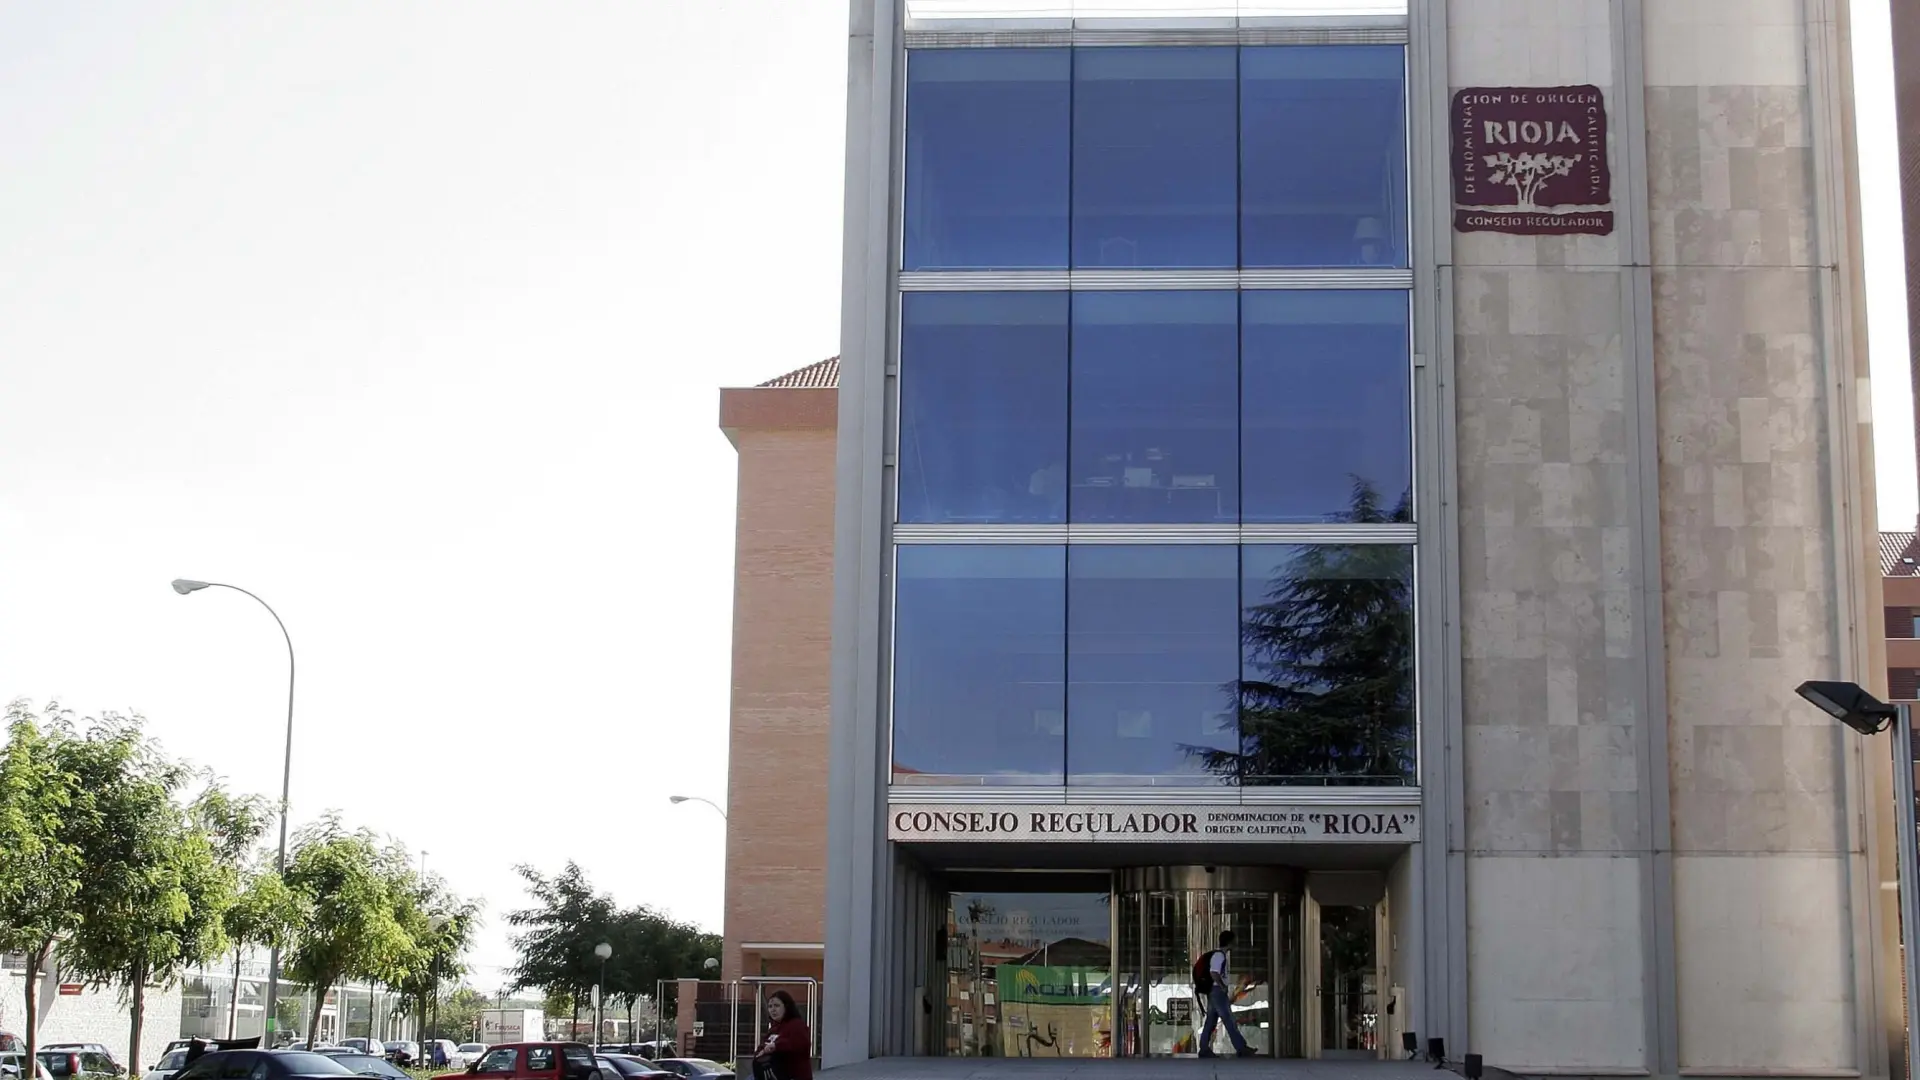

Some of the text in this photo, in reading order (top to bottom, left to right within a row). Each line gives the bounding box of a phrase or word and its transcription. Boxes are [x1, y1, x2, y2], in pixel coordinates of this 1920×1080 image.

[1511, 94, 1528, 103] DE
[1536, 94, 1597, 104] ORIGEN
[1483, 120, 1581, 145] RIOJA
[1587, 106, 1601, 195] CALIFICADA
[1466, 216, 1604, 227] CONSEJO REGULADOR
[894, 811, 1199, 833] CONSEJO REGULADOR
[1207, 813, 1305, 822] DENOMINACION DE
[1204, 825, 1306, 834] ORIGEN CALIFICADA
[959, 915, 1008, 925] COSEJO
